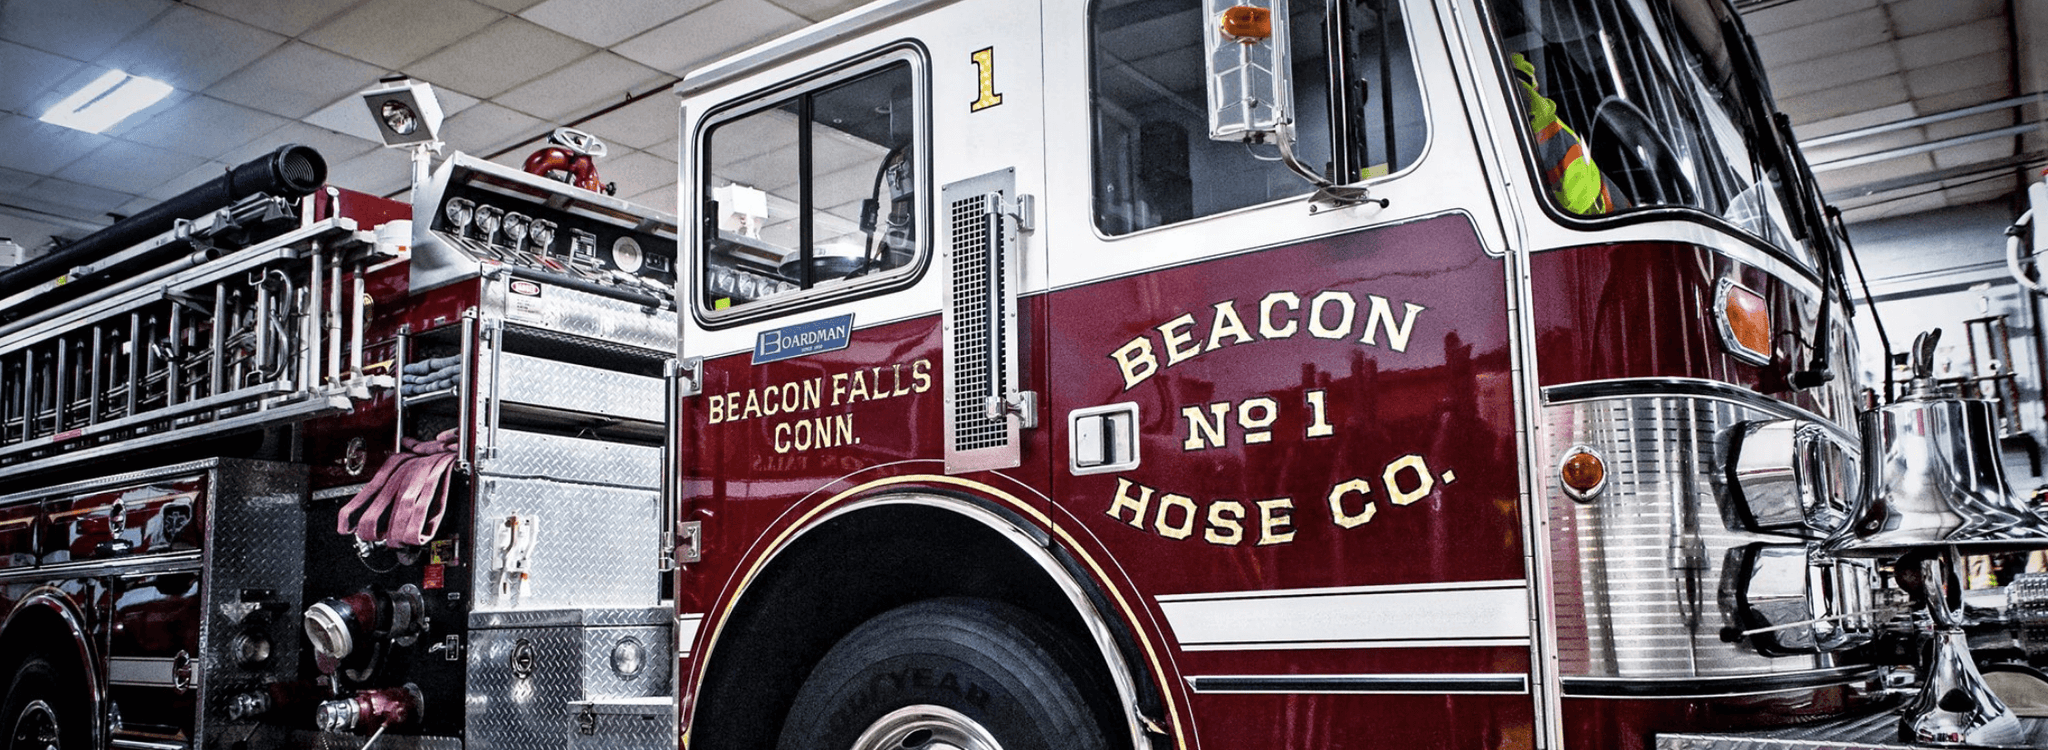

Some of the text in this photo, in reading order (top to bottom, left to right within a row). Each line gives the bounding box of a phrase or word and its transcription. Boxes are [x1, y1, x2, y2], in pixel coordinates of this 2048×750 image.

[970, 45, 1003, 113] 1
[760, 325, 846, 356] BOARDMAN
[1109, 290, 1426, 391] BEACON
[708, 359, 932, 425] BEACON FALLS
[1305, 389, 1334, 438] 1
[774, 412, 861, 454] CONN.
[1105, 454, 1456, 546] HOSE CO.
